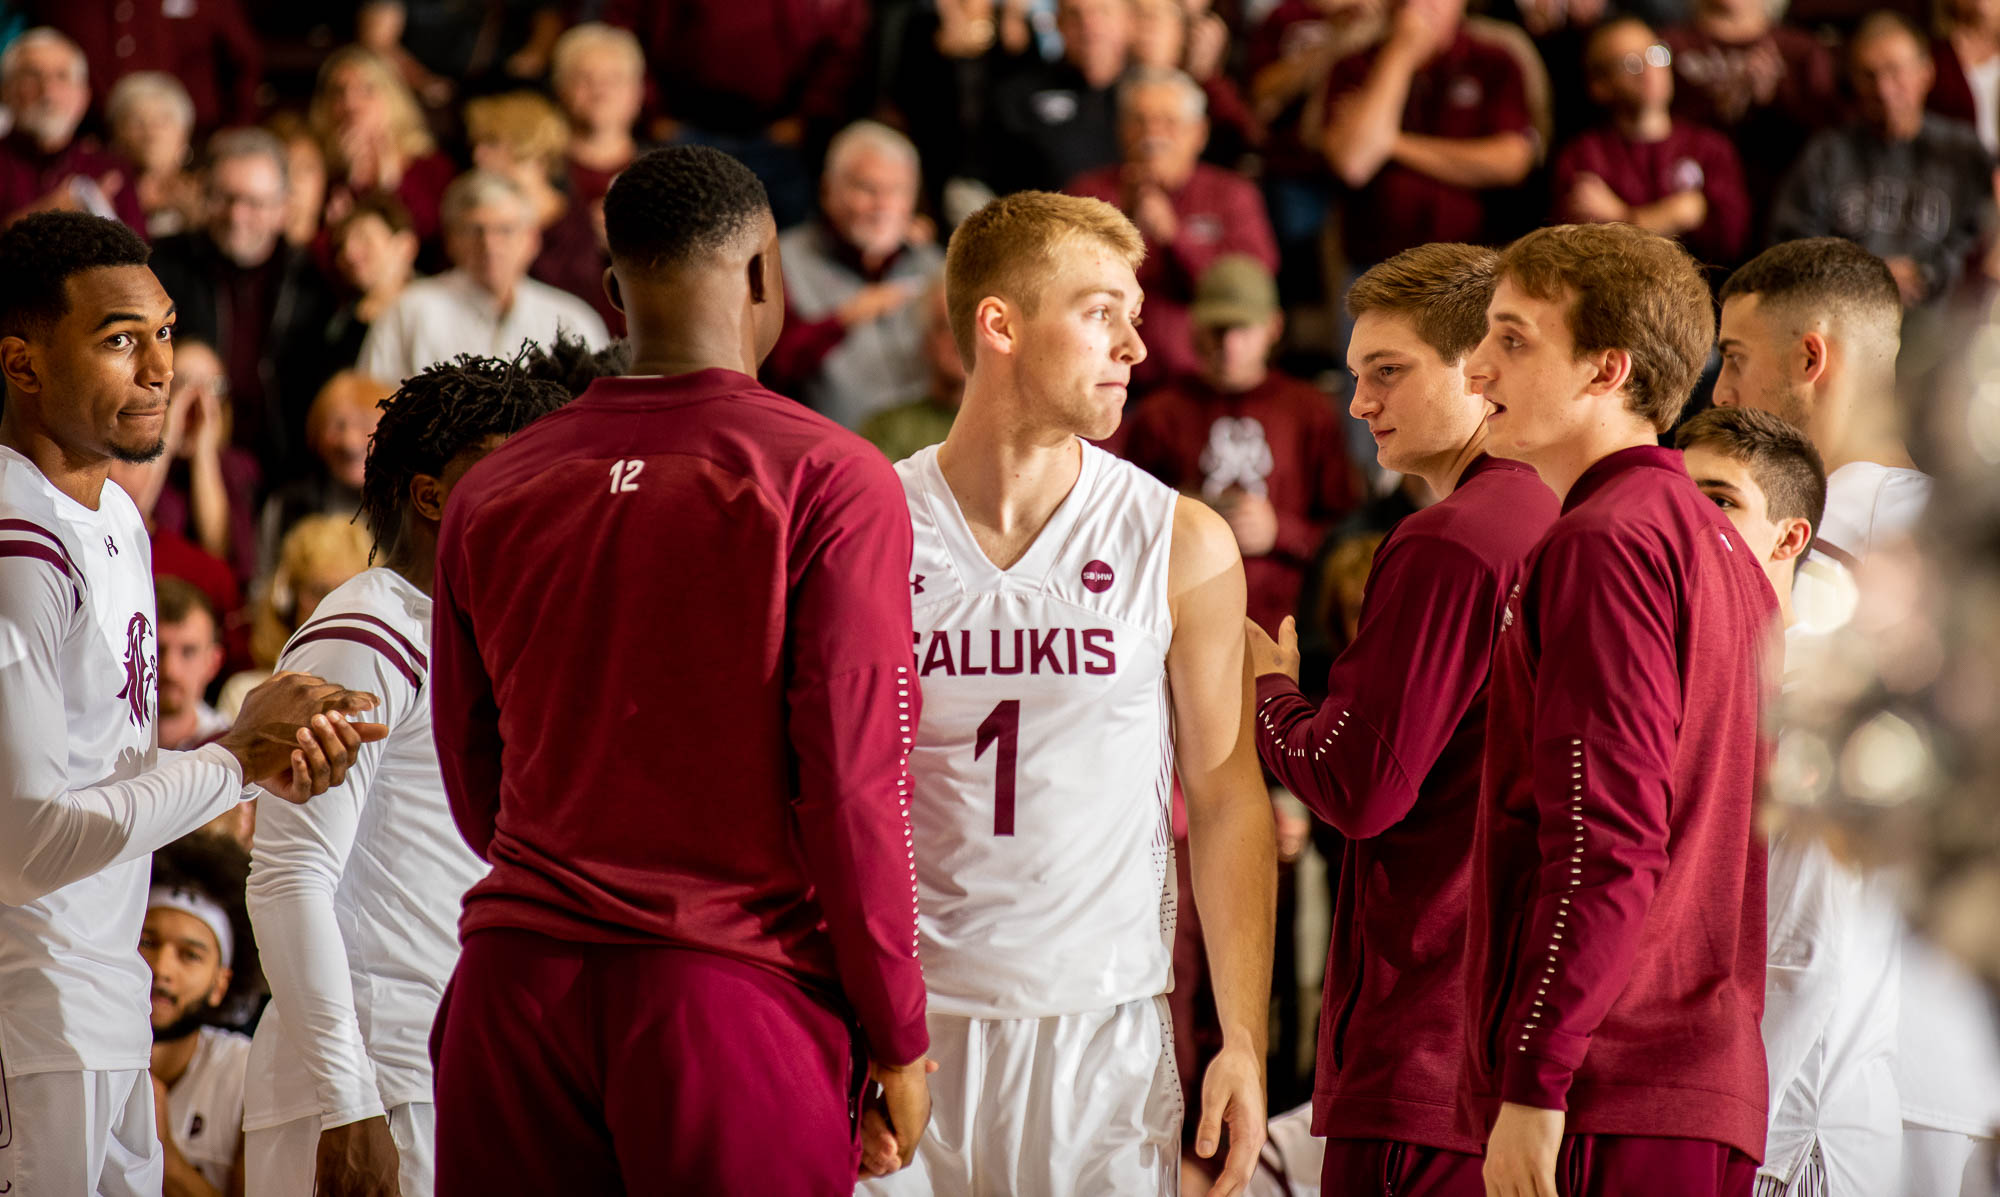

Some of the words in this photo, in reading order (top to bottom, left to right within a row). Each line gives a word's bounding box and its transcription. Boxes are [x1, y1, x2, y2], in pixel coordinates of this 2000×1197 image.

[609, 459, 645, 494] 12
[913, 628, 1116, 676] ALUKIS
[975, 699, 1020, 836] 1
